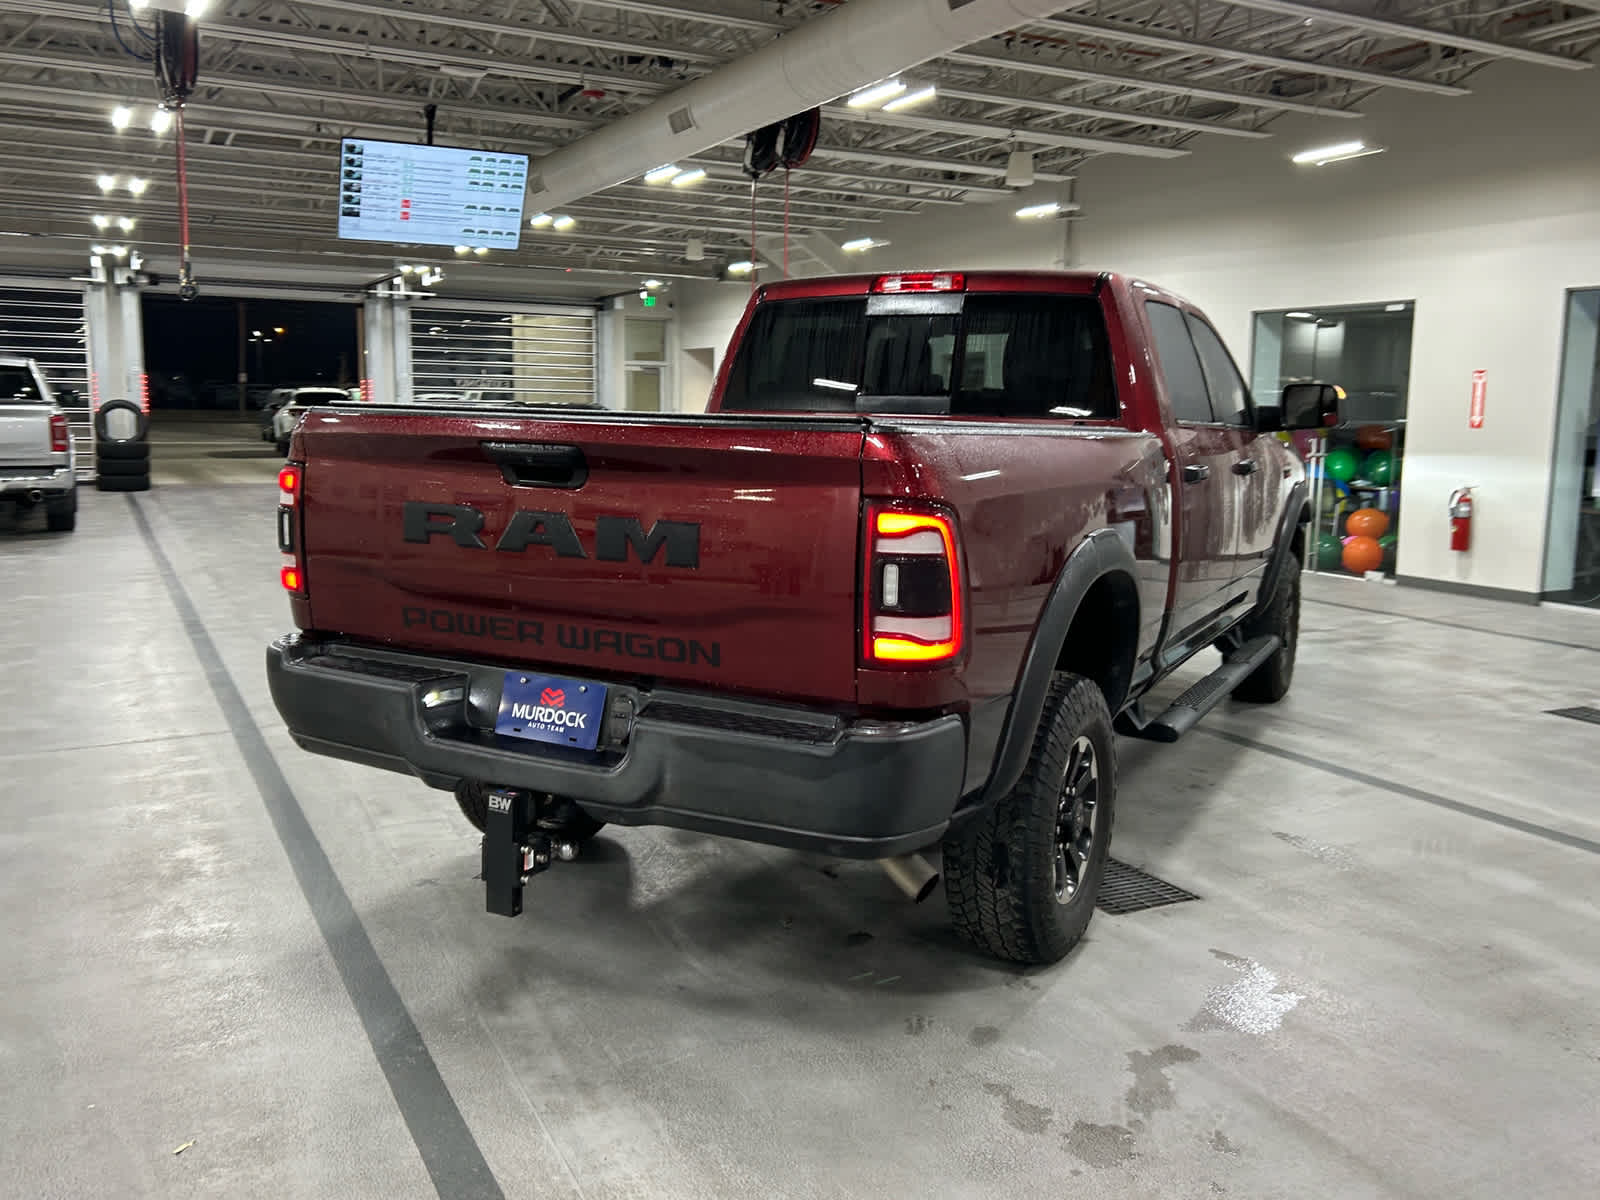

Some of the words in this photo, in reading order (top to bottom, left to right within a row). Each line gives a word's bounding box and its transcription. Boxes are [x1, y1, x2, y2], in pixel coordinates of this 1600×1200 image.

[403, 501, 701, 569] RAM
[402, 607, 544, 645] POWER
[558, 624, 720, 667] WAGON
[512, 703, 587, 728] MURDOCK
[528, 721, 545, 730] AUTO
[547, 724, 565, 733] TEAM
